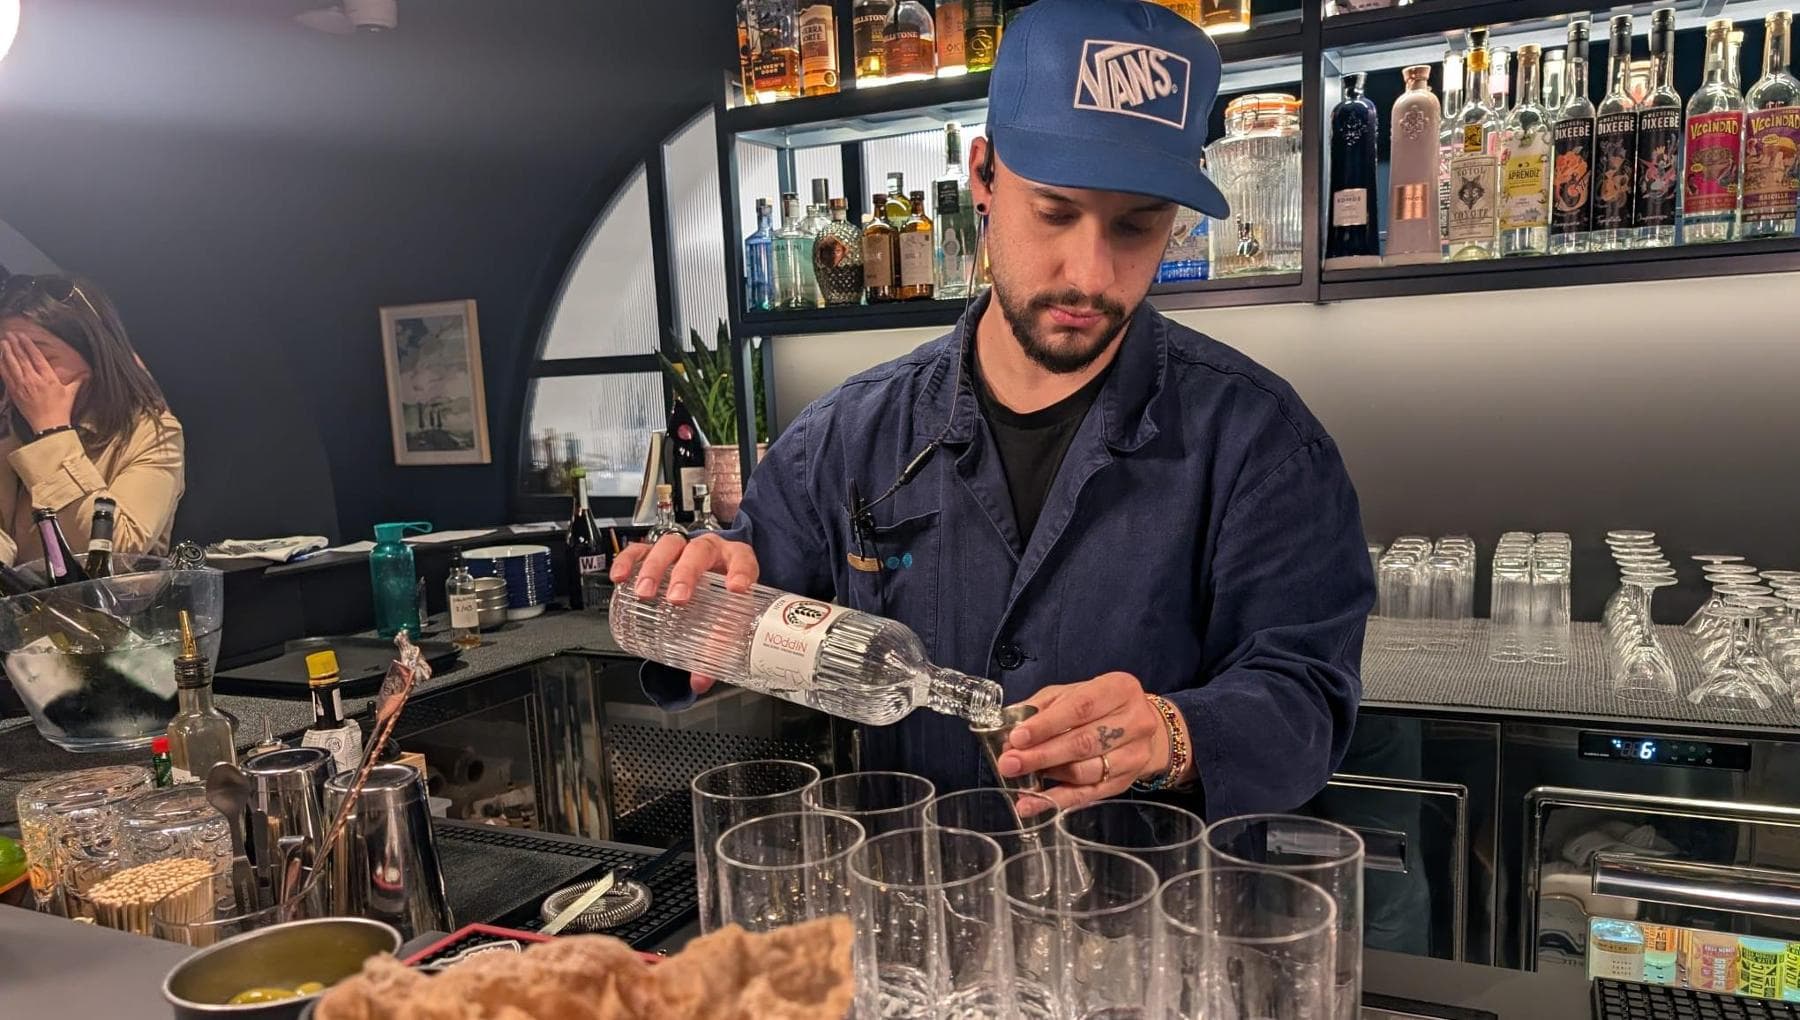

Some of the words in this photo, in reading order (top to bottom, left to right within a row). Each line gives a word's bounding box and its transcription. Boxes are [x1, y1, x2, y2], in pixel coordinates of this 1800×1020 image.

[1597, 119, 1634, 135] DIXEEBE
[1641, 116, 1680, 130] DIXEEBE
[1555, 125, 1590, 140] DIXEEBE
[764, 631, 808, 653] NIPPON
[1639, 742, 1653, 759] 6
[1750, 963, 1764, 995] TONIC
